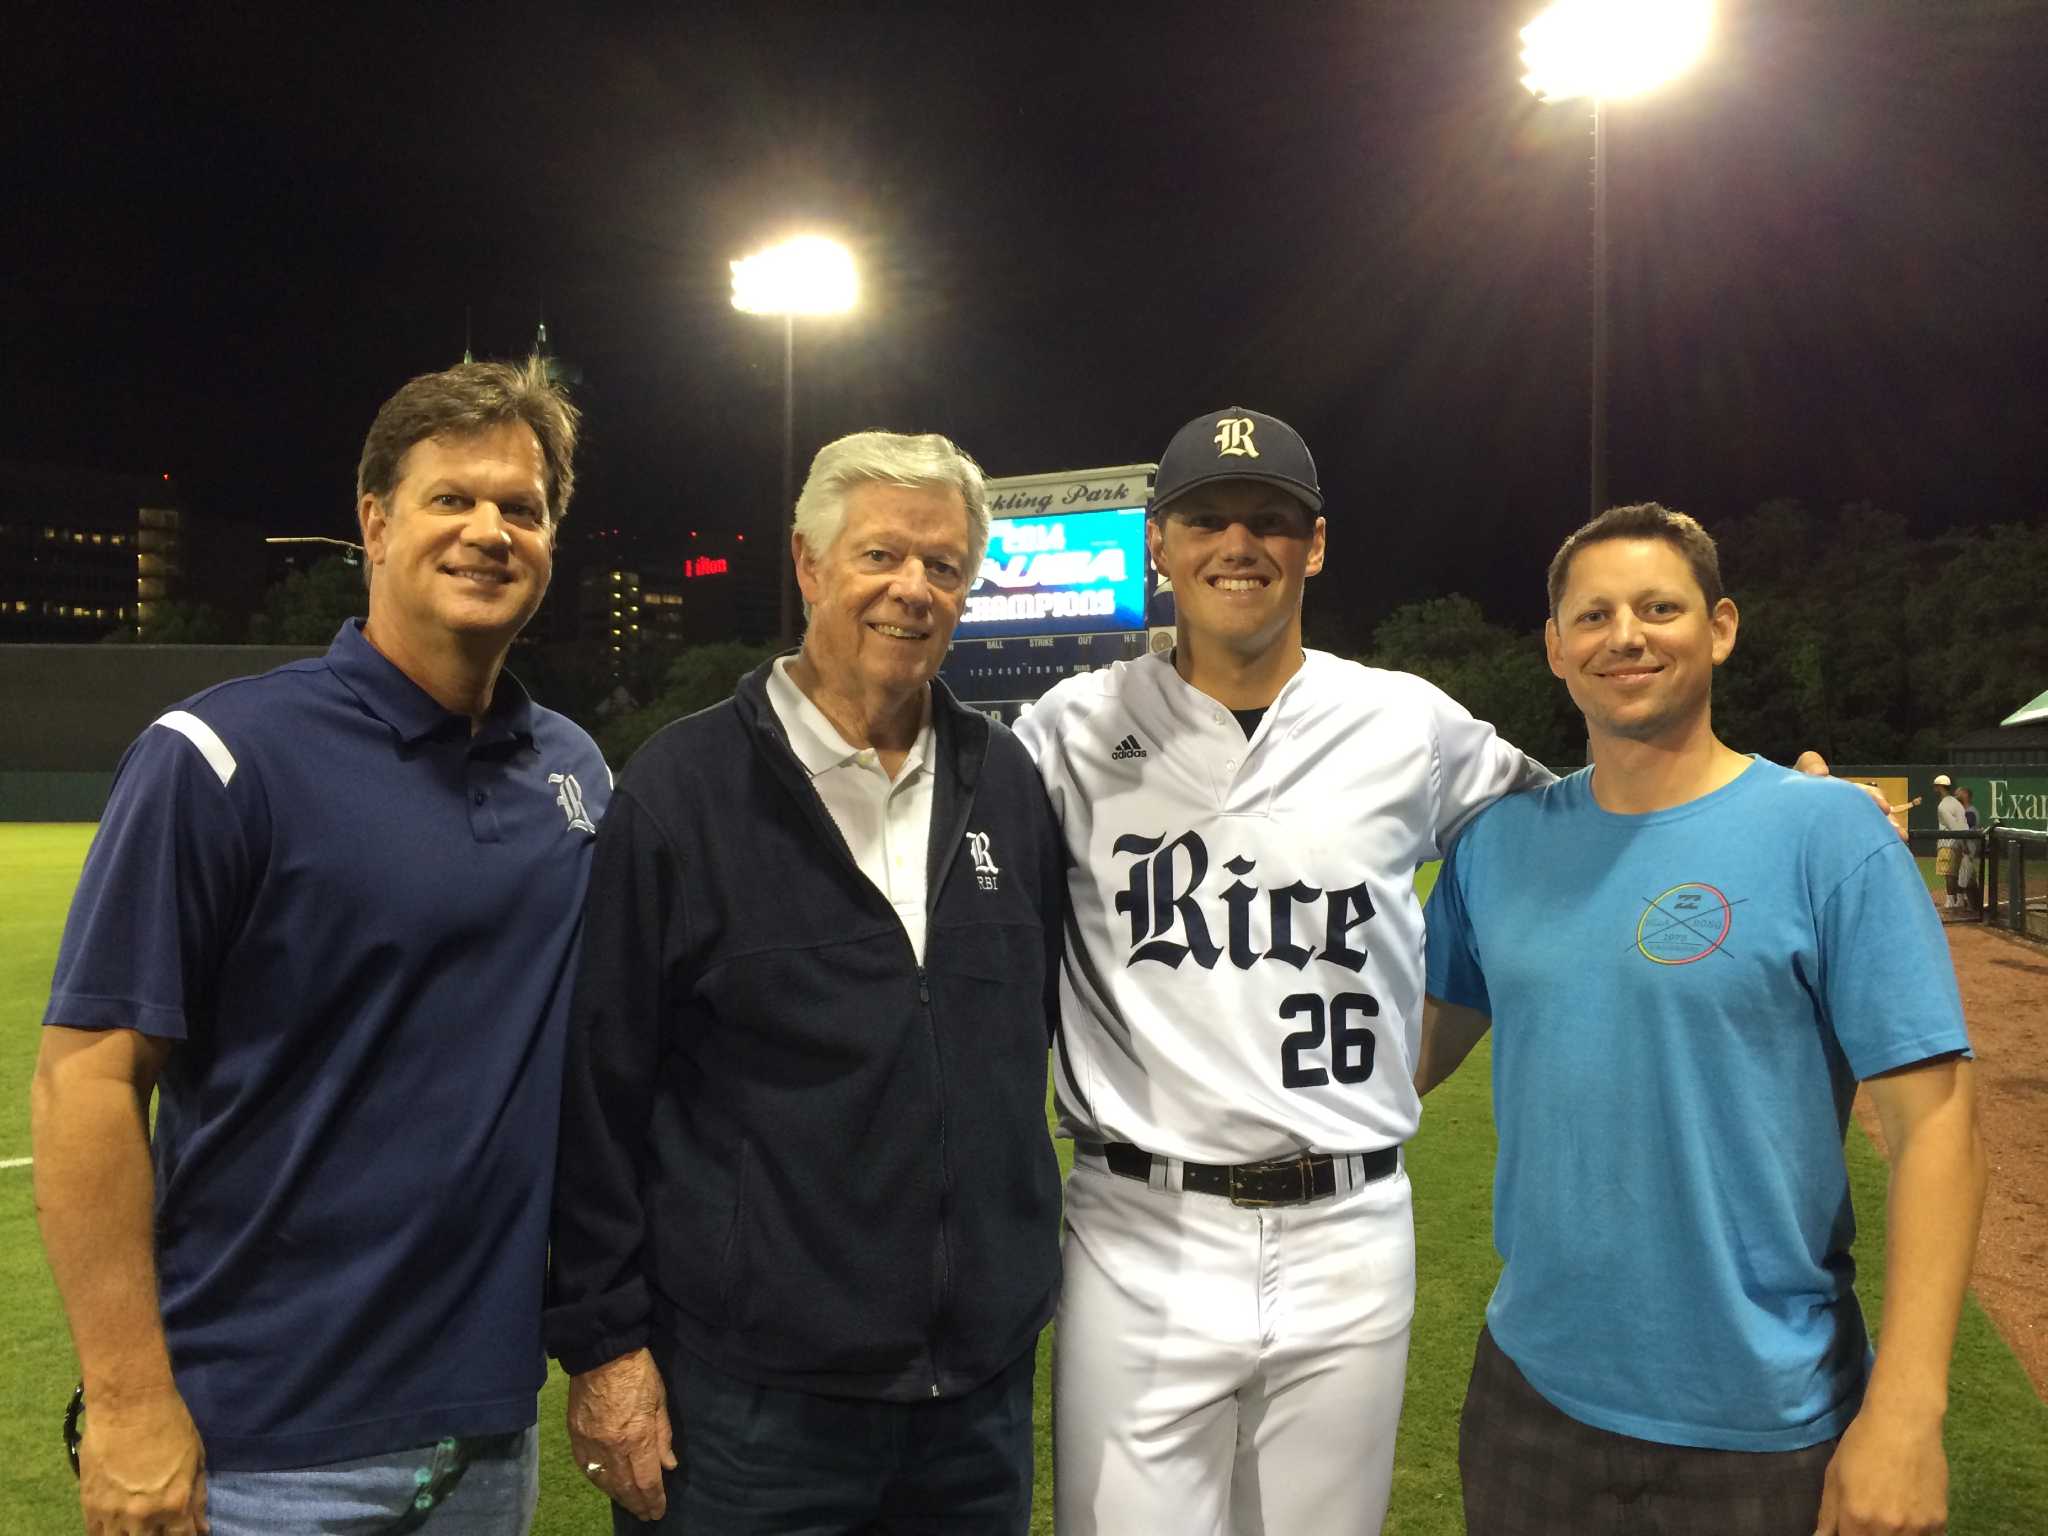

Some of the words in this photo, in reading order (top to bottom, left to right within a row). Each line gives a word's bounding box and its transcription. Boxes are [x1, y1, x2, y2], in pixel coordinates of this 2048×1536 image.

[1213, 418, 1260, 458] R
[1062, 483, 1129, 504] Park
[986, 640, 1003, 649] BALL
[1029, 639, 1054, 648] STRIKE
[1078, 636, 1092, 646] OUT
[1112, 748, 1147, 760] adidas
[548, 773, 596, 834] R
[966, 831, 999, 874] R
[1112, 829, 1377, 973] Rice
[1278, 992, 1380, 1089] 26
